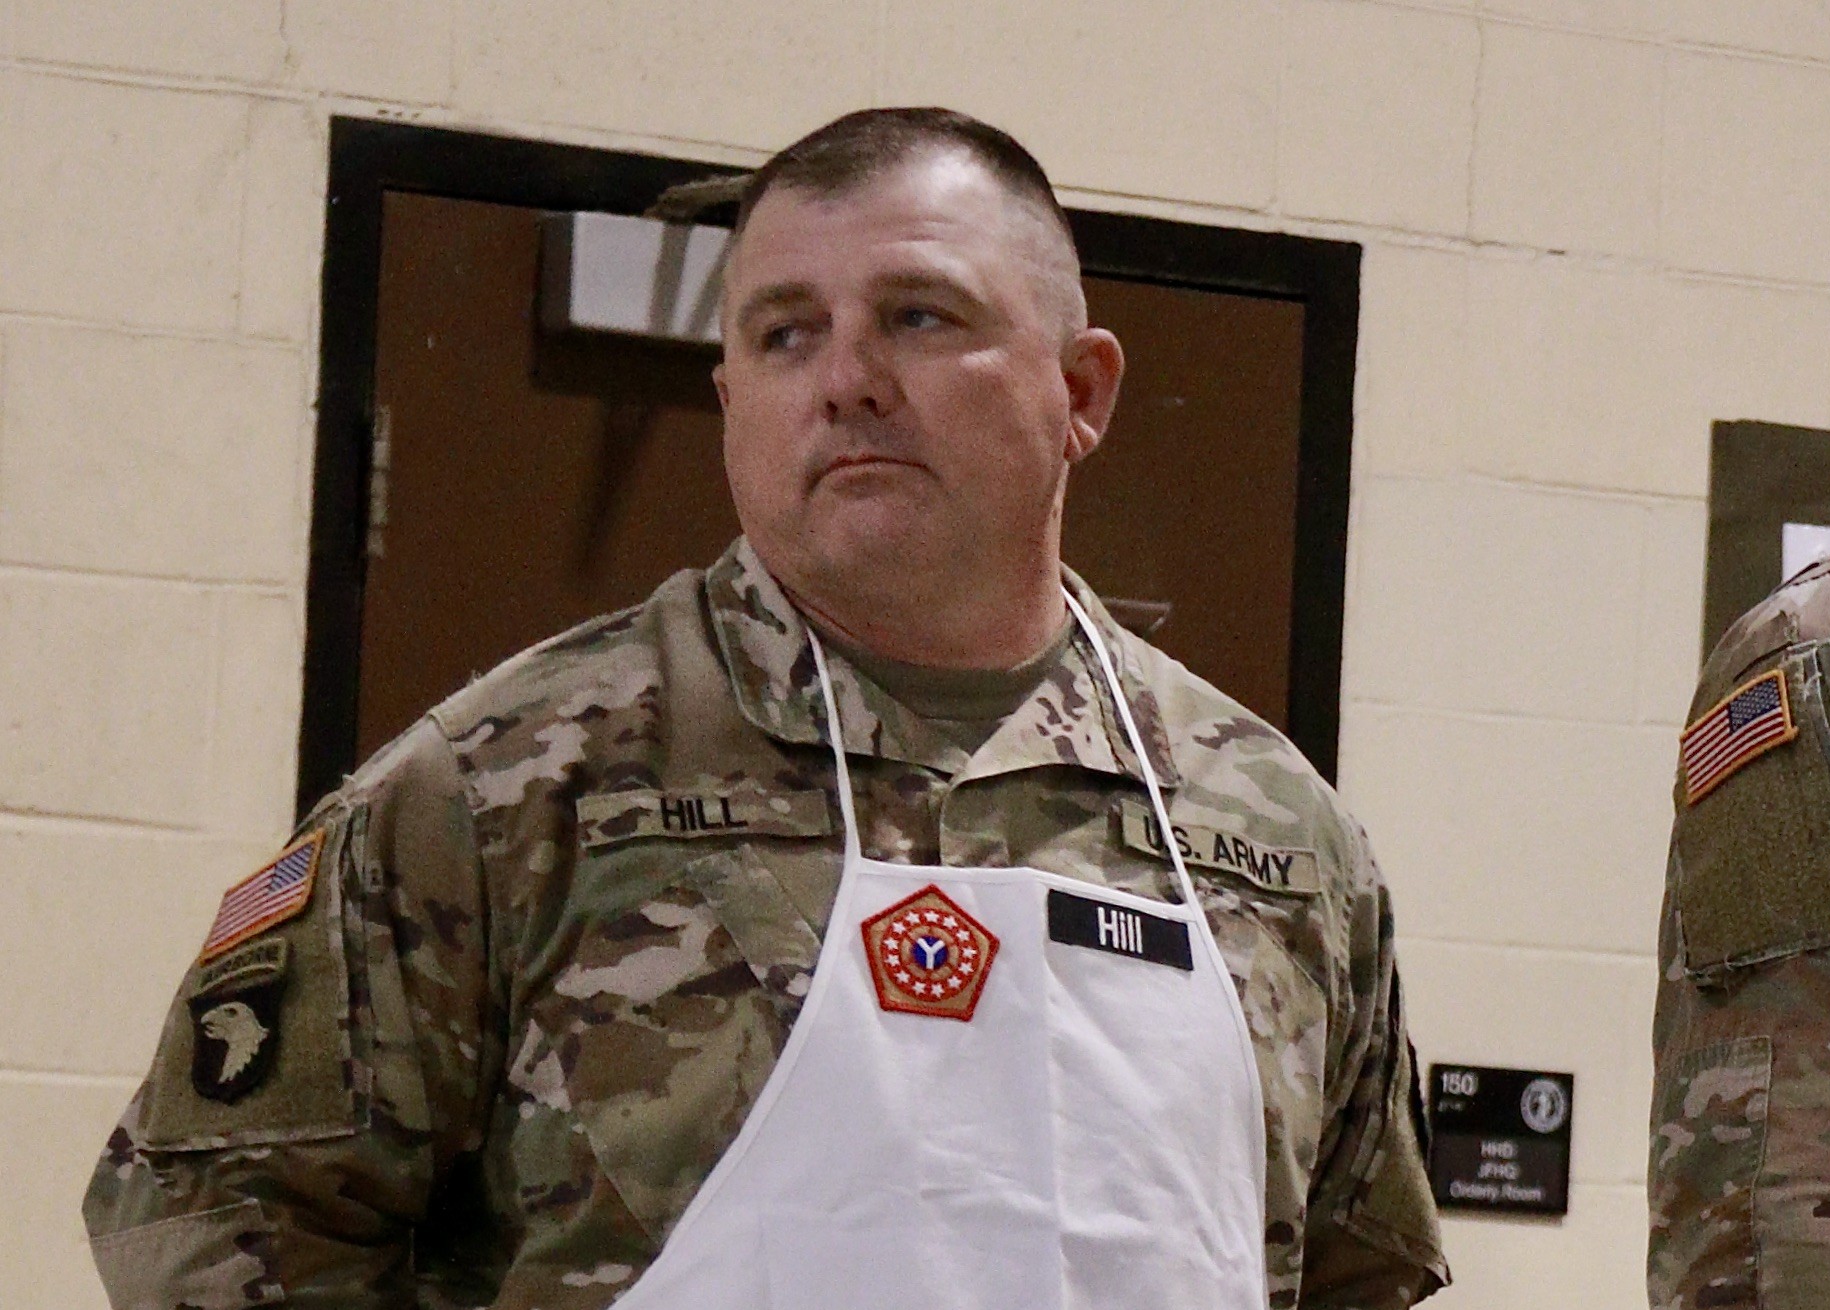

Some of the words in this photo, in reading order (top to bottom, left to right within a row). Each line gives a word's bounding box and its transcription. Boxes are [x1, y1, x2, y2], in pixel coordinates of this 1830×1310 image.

[659, 796, 749, 832] HILL
[1212, 832, 1294, 886] ARMY
[1096, 905, 1144, 955] Hill
[1441, 1070, 1479, 1097] 150
